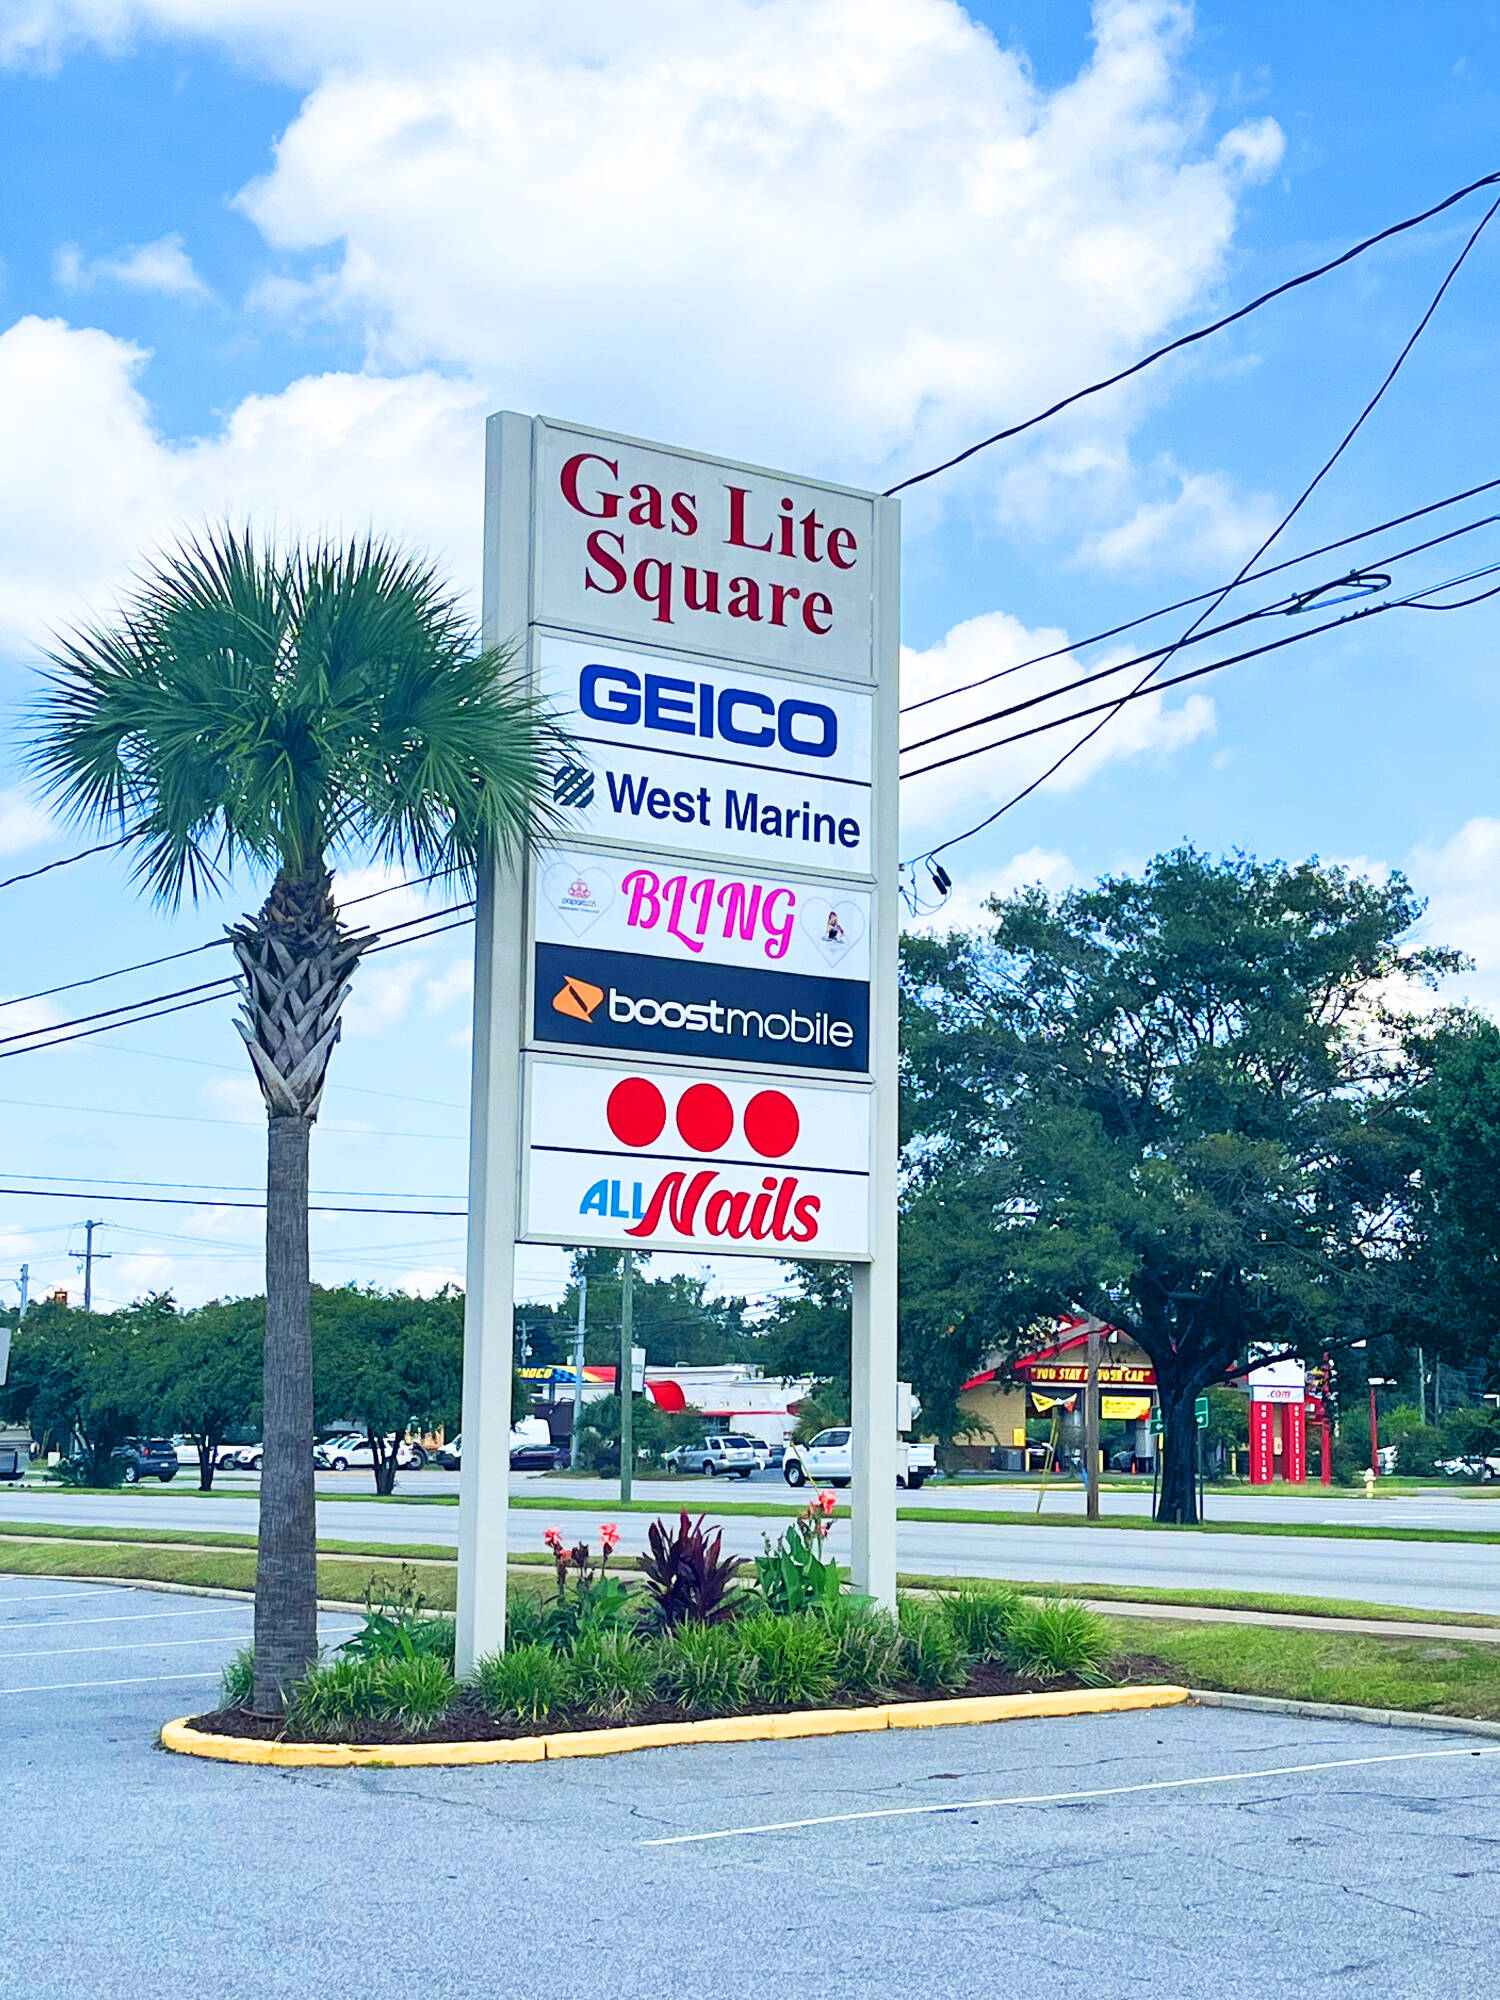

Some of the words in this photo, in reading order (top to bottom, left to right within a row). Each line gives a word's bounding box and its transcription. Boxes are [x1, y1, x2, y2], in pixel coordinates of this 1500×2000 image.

[560, 453, 699, 536] Gas
[722, 485, 858, 570] Lite
[585, 529, 834, 635] Square
[579, 663, 838, 758] GEICO
[605, 771, 711, 827] West
[724, 789, 861, 849] Marine
[621, 869, 796, 960] BLING
[579, 1178, 647, 1220] ALL
[623, 1170, 822, 1243] Nails
[517, 1367, 552, 1379] NOCO
[1060, 1368, 1082, 1380] STAY
